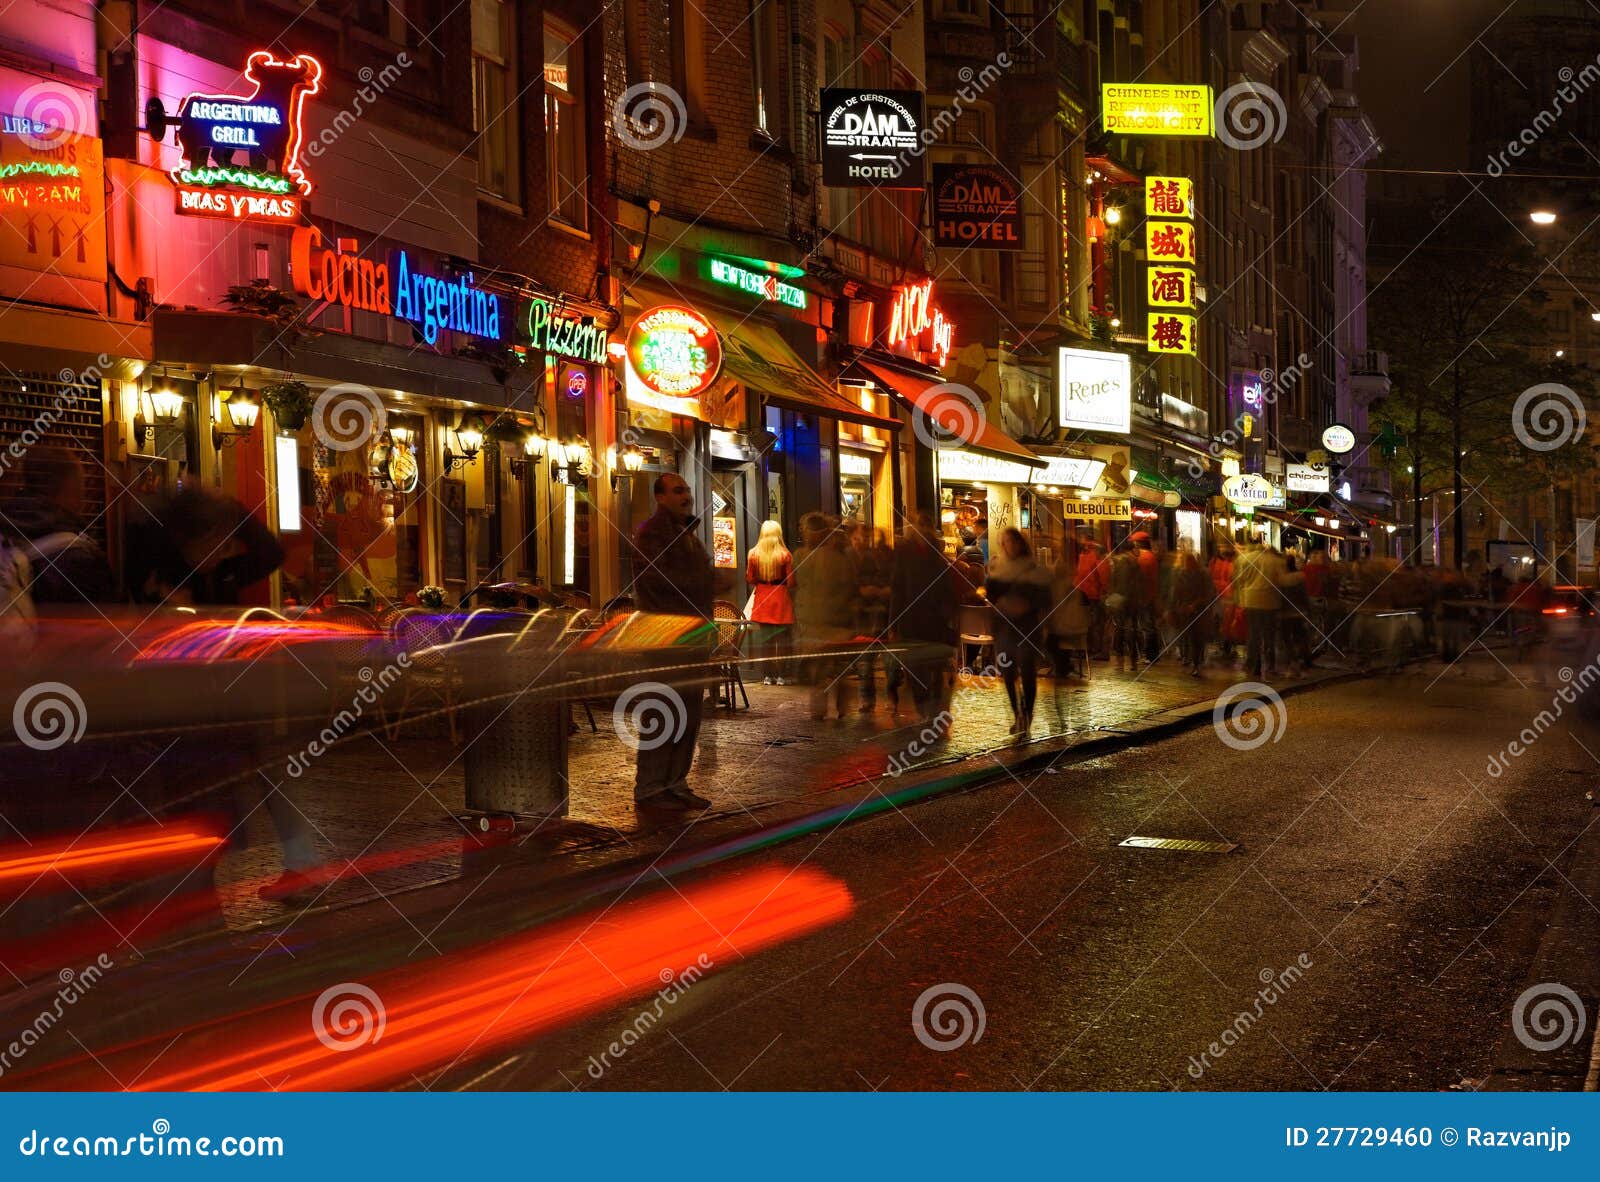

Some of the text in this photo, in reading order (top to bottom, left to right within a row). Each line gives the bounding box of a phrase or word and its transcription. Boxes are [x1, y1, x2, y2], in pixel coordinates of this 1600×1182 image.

[1106, 87, 1203, 99] CHINEES IND.
[190, 101, 281, 124] ARGENTINA
[827, 94, 917, 130] HOTEL DE GERSTEKORREL
[1109, 101, 1200, 113] RESTAURANT
[845, 104, 899, 136] DAM
[1107, 115, 1203, 129] DRAGON CITY
[211, 126, 260, 146] GRILL
[847, 135, 898, 147] STRAAT
[849, 166, 897, 178] HOTEL
[954, 178, 1001, 205] DAM
[181, 191, 294, 218] MAS Y MAS
[956, 204, 999, 215] STRAAT
[939, 221, 1018, 241] HOTEL
[292, 226, 391, 314] Cocina
[1149, 180, 1186, 350] 龍城酒樓
[395, 250, 500, 346] Argentina
[529, 299, 608, 365] Pizzeria
[1228, 487, 1240, 497] LA
[1066, 502, 1129, 516] OLIEBOLLEN
